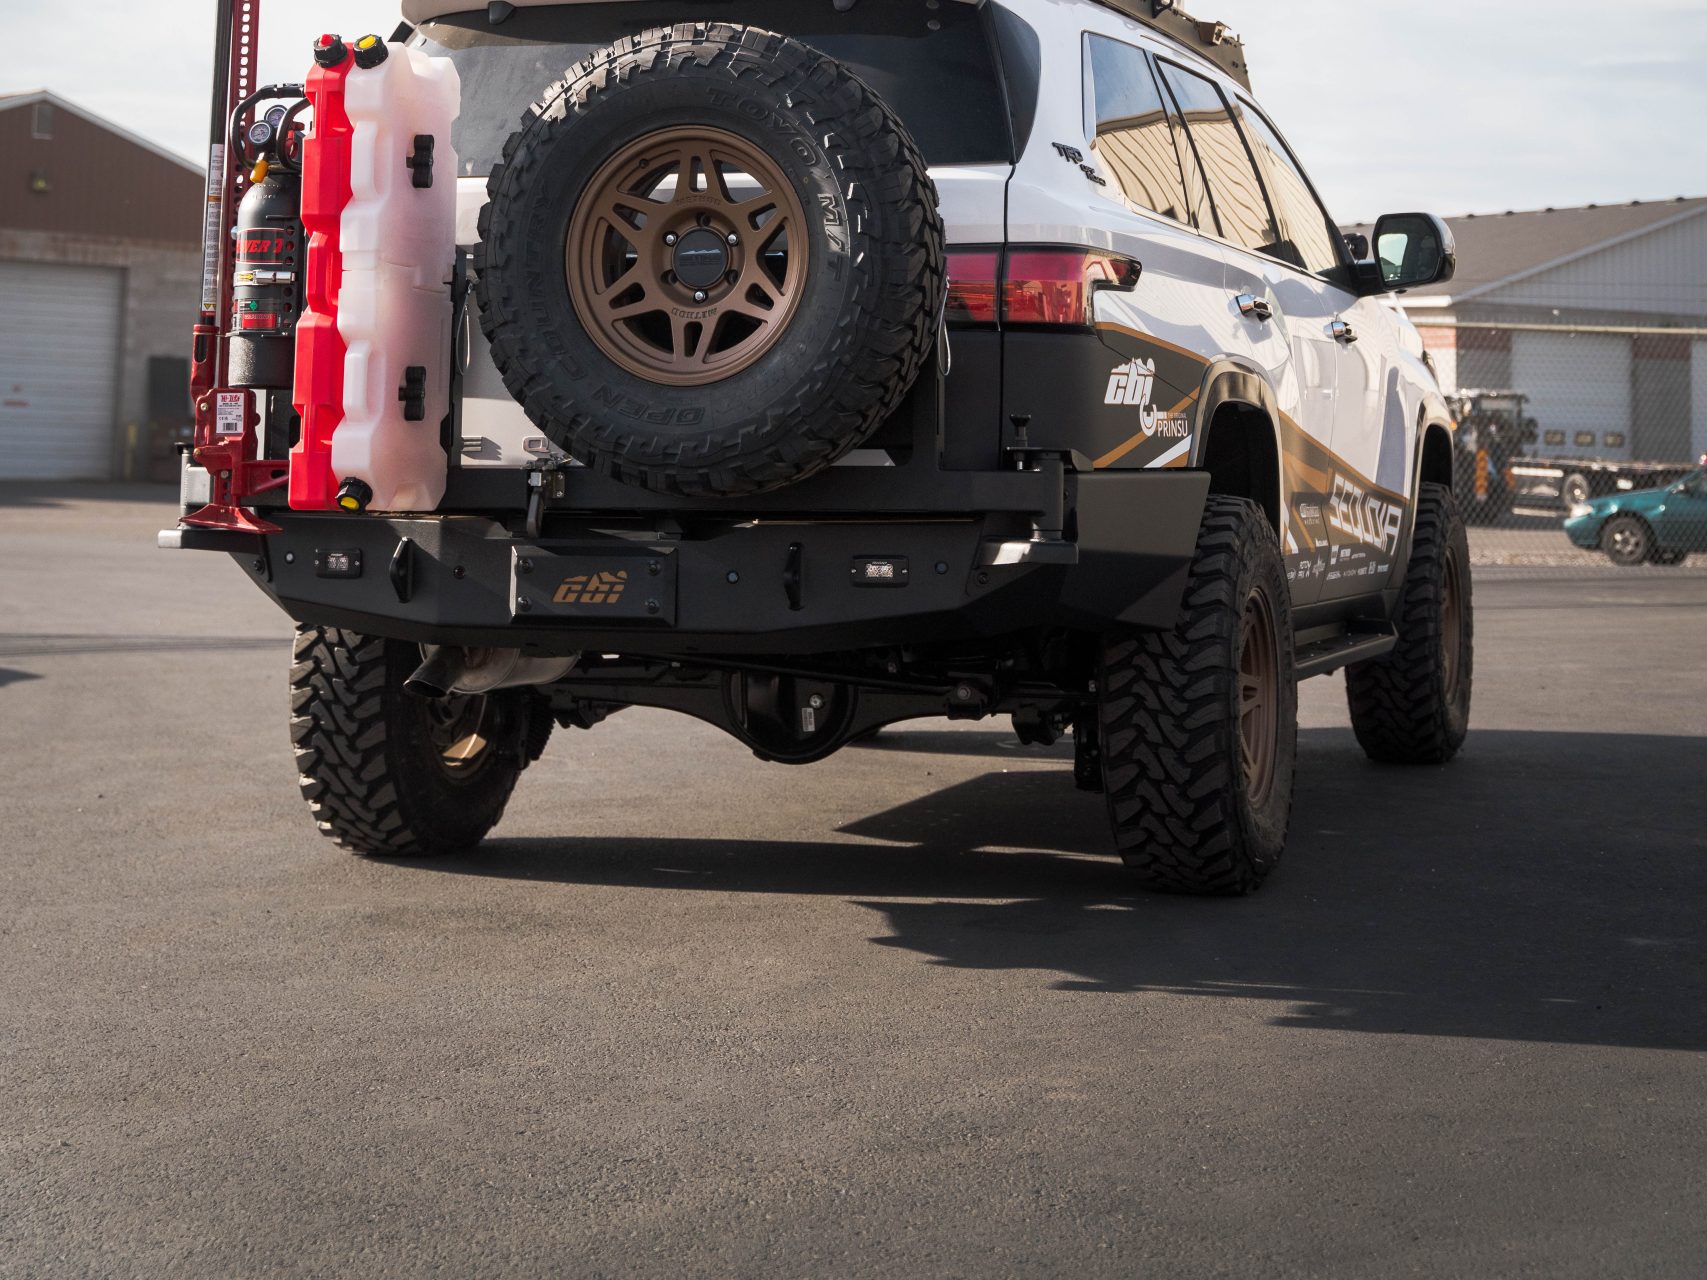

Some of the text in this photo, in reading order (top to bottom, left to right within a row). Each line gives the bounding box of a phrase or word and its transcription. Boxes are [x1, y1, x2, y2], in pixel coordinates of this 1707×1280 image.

[1051, 141, 1084, 164] TRD
[1157, 419, 1188, 437] PRINSU
[1329, 473, 1402, 556] SEQUOIA
